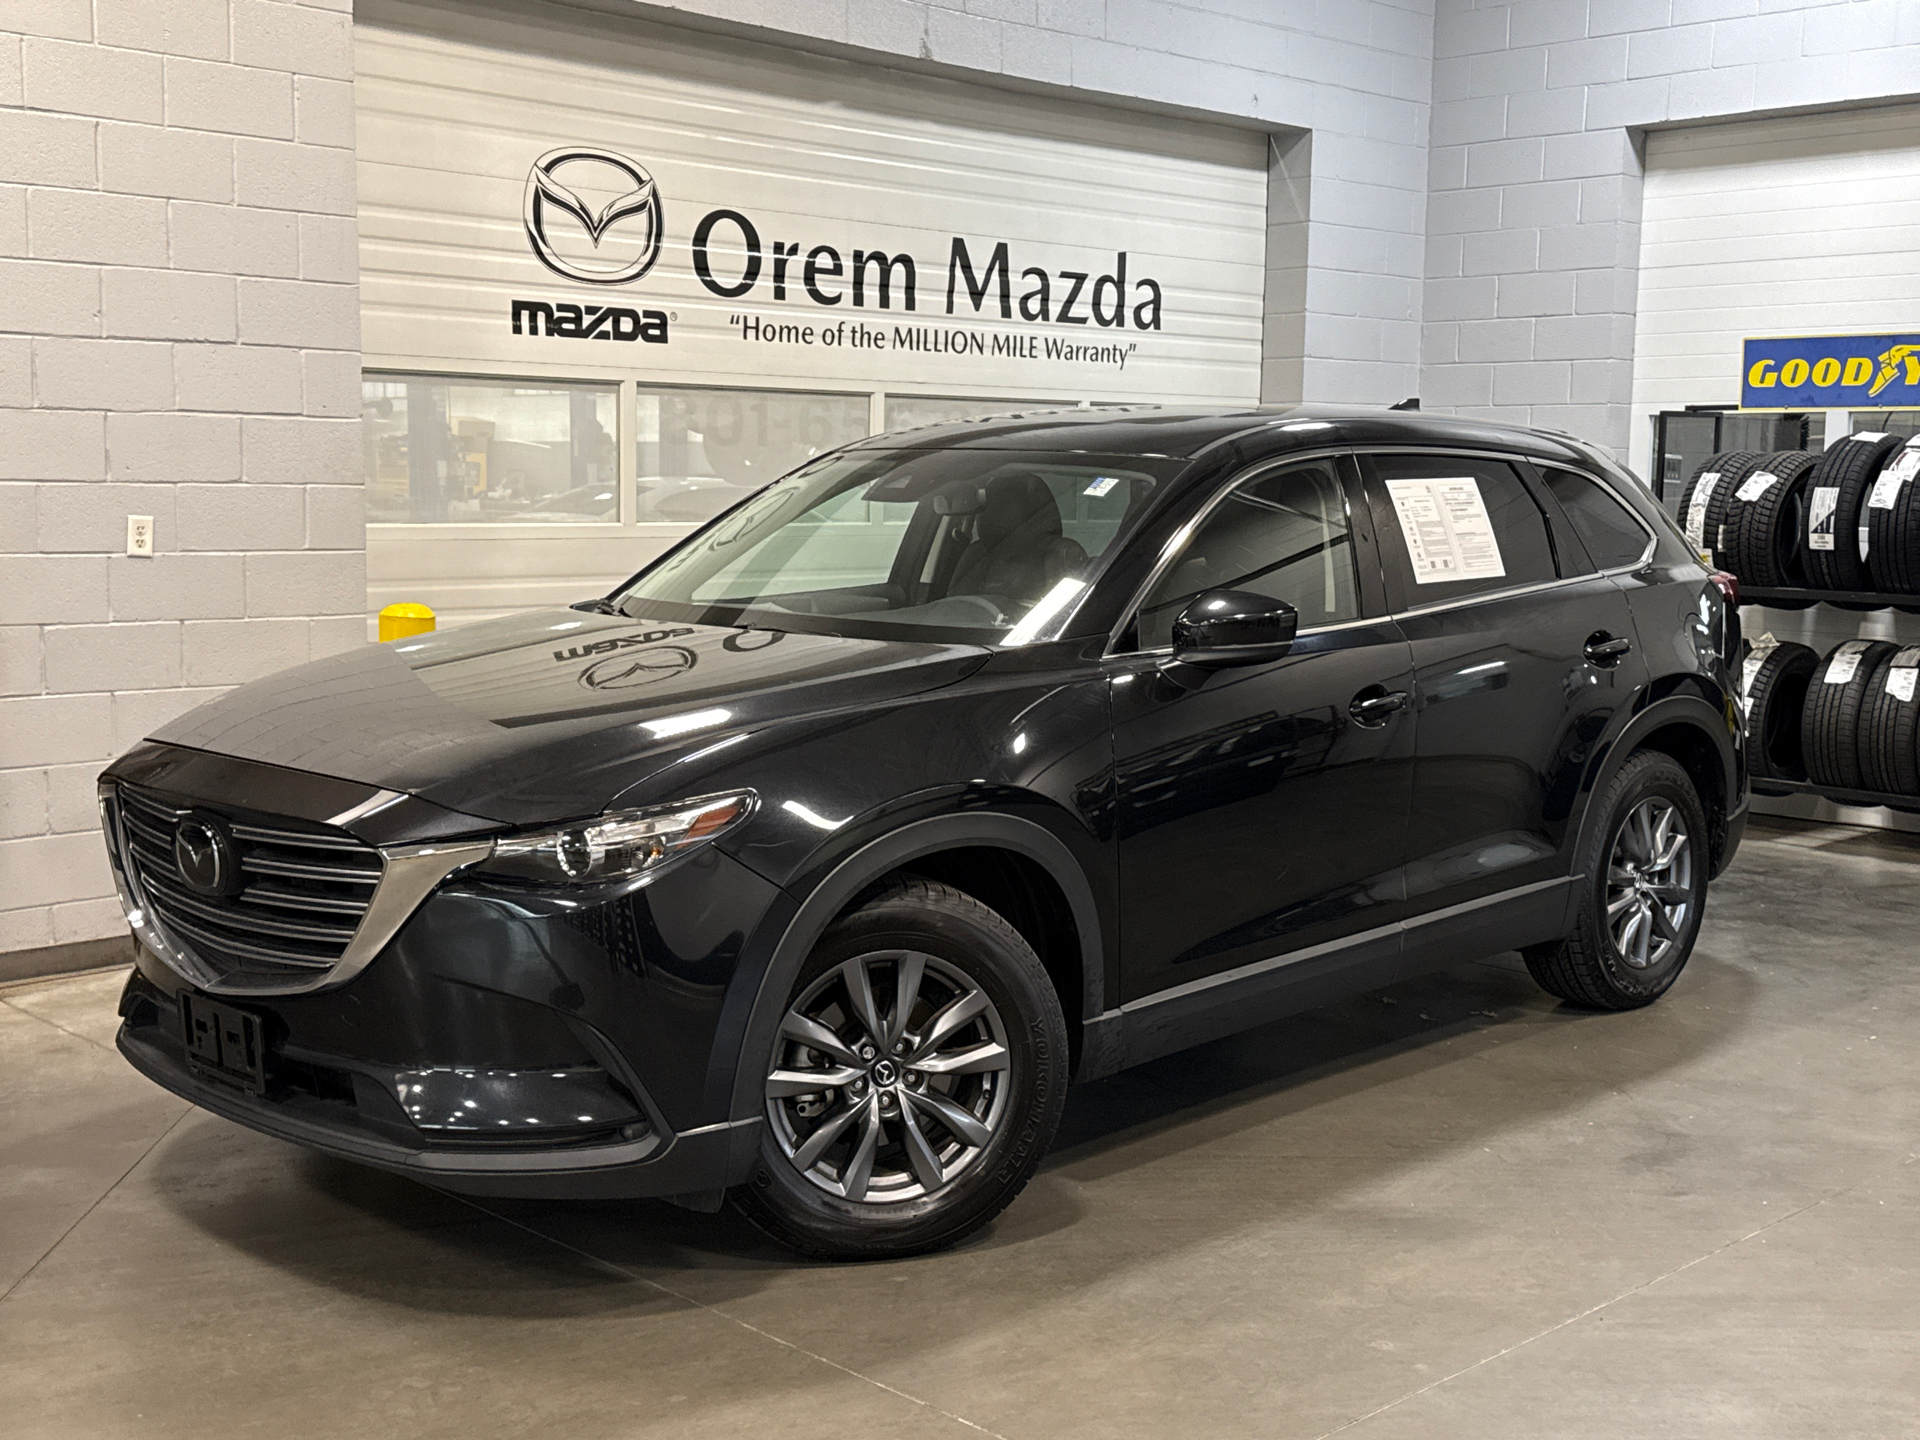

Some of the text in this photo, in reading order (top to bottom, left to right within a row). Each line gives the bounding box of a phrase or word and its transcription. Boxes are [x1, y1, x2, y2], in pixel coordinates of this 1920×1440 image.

[692, 209, 1162, 331] Orem Mazda
[822, 321, 846, 346] of
[850, 323, 886, 349] the
[892, 326, 985, 355] MILLION
[991, 333, 1038, 358] MILE
[998, 1016, 1050, 1184] YOKOHAMA
